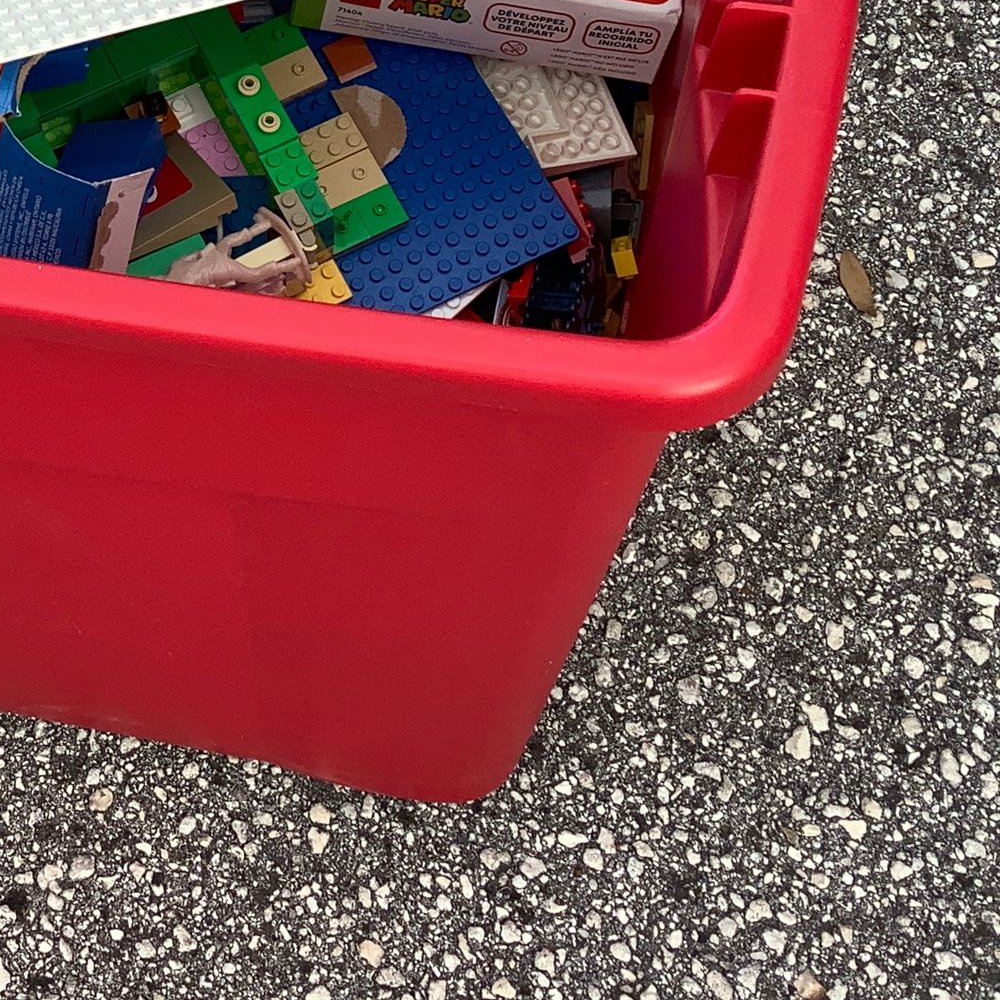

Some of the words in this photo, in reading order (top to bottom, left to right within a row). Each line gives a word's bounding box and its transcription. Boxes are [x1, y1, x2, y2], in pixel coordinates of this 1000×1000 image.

[337, 6, 362, 15] 71404
[497, 7, 566, 25] DÉVELOPPEZ
[491, 15, 528, 27] VOTRE
[528, 21, 568, 33] NIVEAU
[497, 23, 512, 31] DE
[512, 24, 555, 38] DÉPART
[594, 22, 636, 36] AMPLÍA
[637, 30, 653, 39] TU
[588, 29, 654, 46] RECORRIDO
[598, 38, 638, 50] INICIAL
